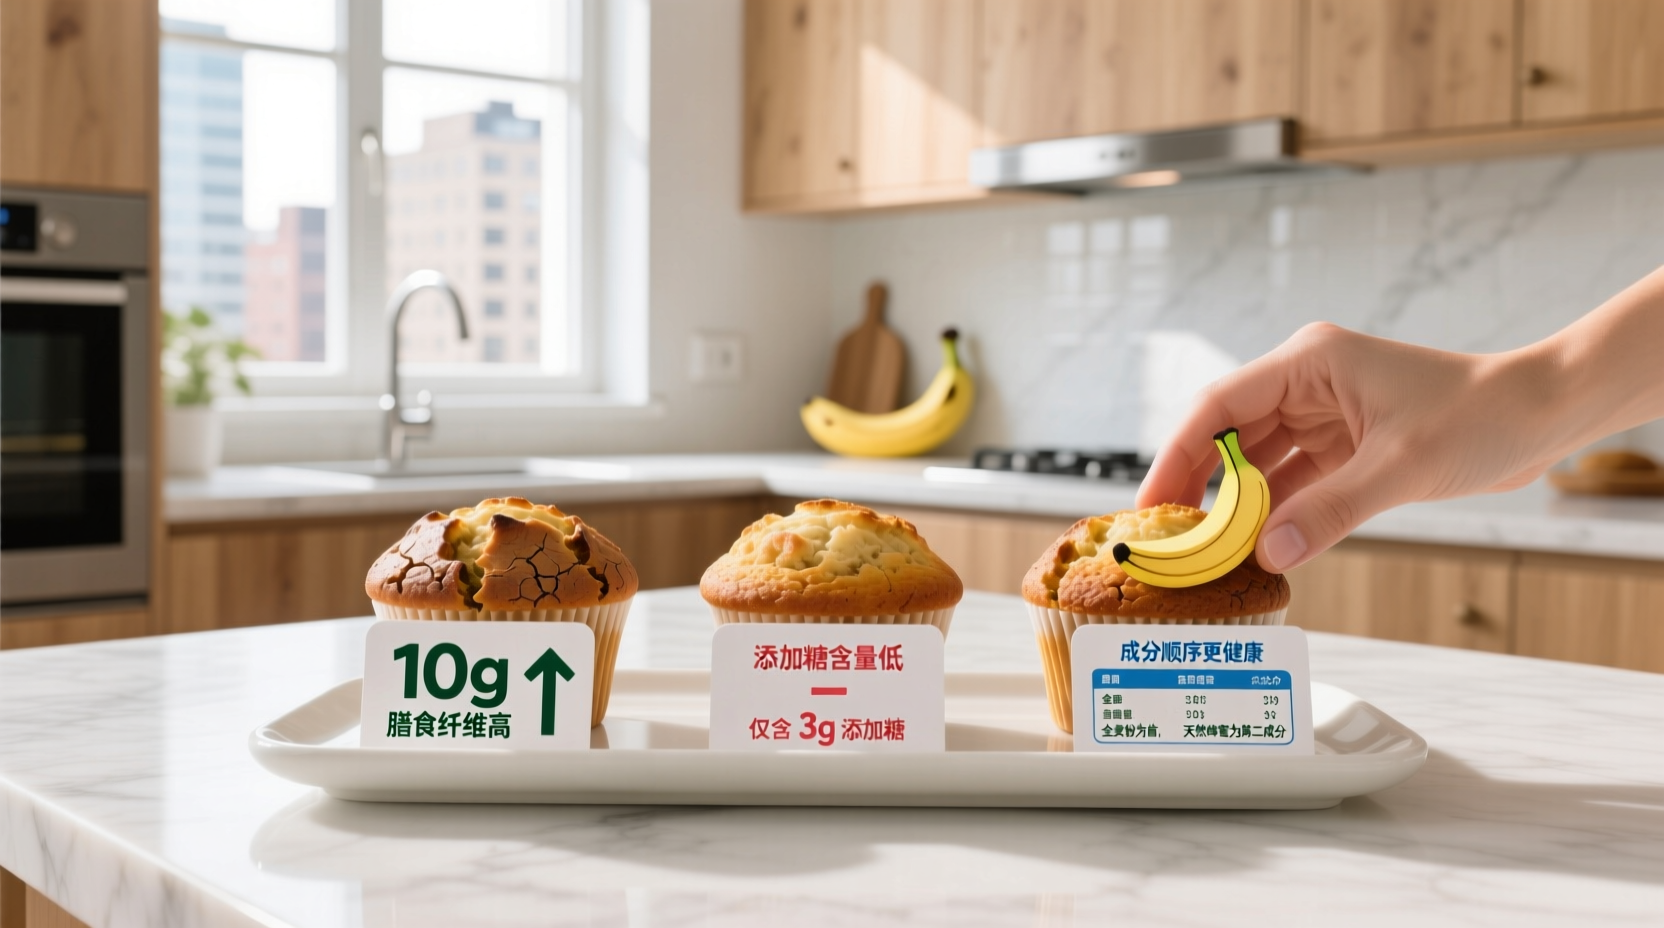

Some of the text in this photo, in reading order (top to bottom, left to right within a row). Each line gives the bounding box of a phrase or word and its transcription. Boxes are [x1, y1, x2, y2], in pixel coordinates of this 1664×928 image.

[754, 644, 903, 671] 添加糖含量低
[1121, 640, 1263, 663] 成分顺序更健康
[394, 643, 508, 708] 10g
[387, 711, 511, 739] 膳食纤维高
[749, 712, 904, 746] 仅含 3g 添加糖
